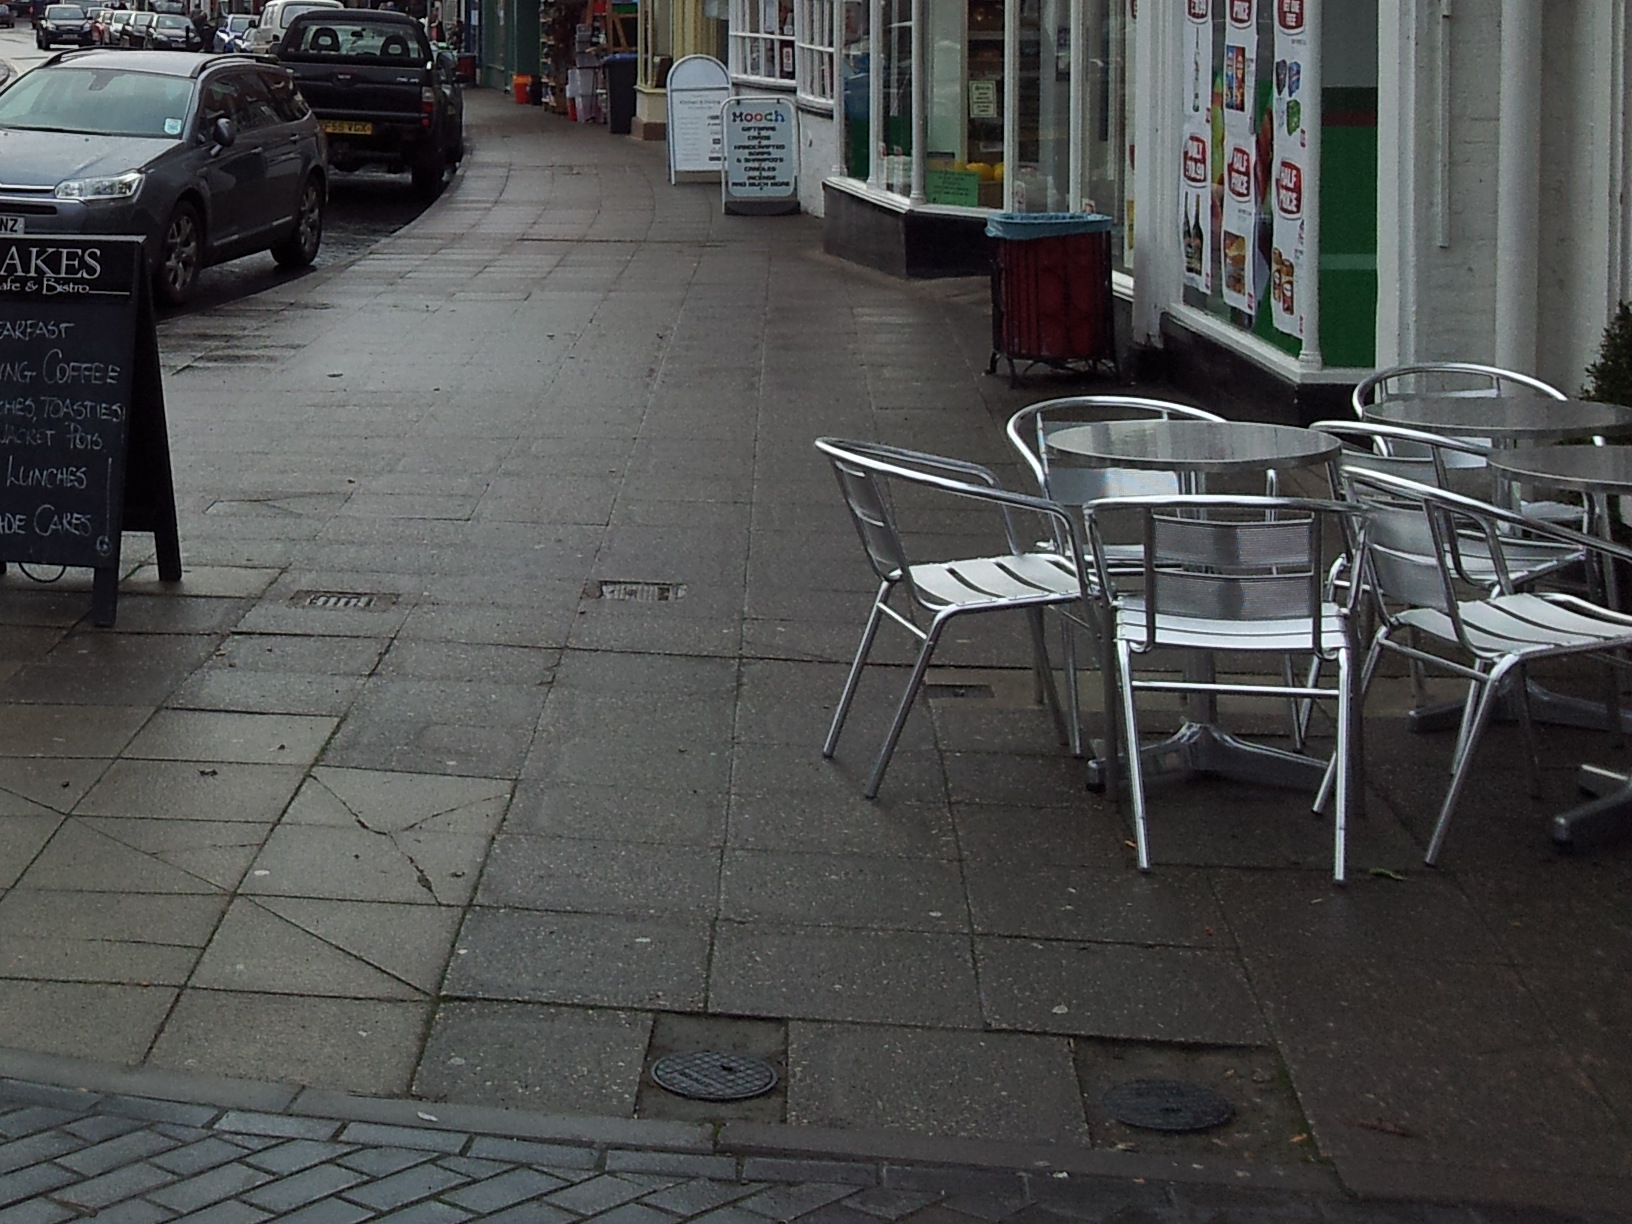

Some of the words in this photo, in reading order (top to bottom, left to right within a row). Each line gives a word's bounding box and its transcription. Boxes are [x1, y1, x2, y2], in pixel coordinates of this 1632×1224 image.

[731, 109, 785, 122] Mooch
[25, 280, 38, 292] &
[42, 277, 90, 295] Bistro
[43, 348, 121, 384] COFFEE
[6, 455, 88, 489] LUNCHES
[34, 504, 92, 537] CAKES
